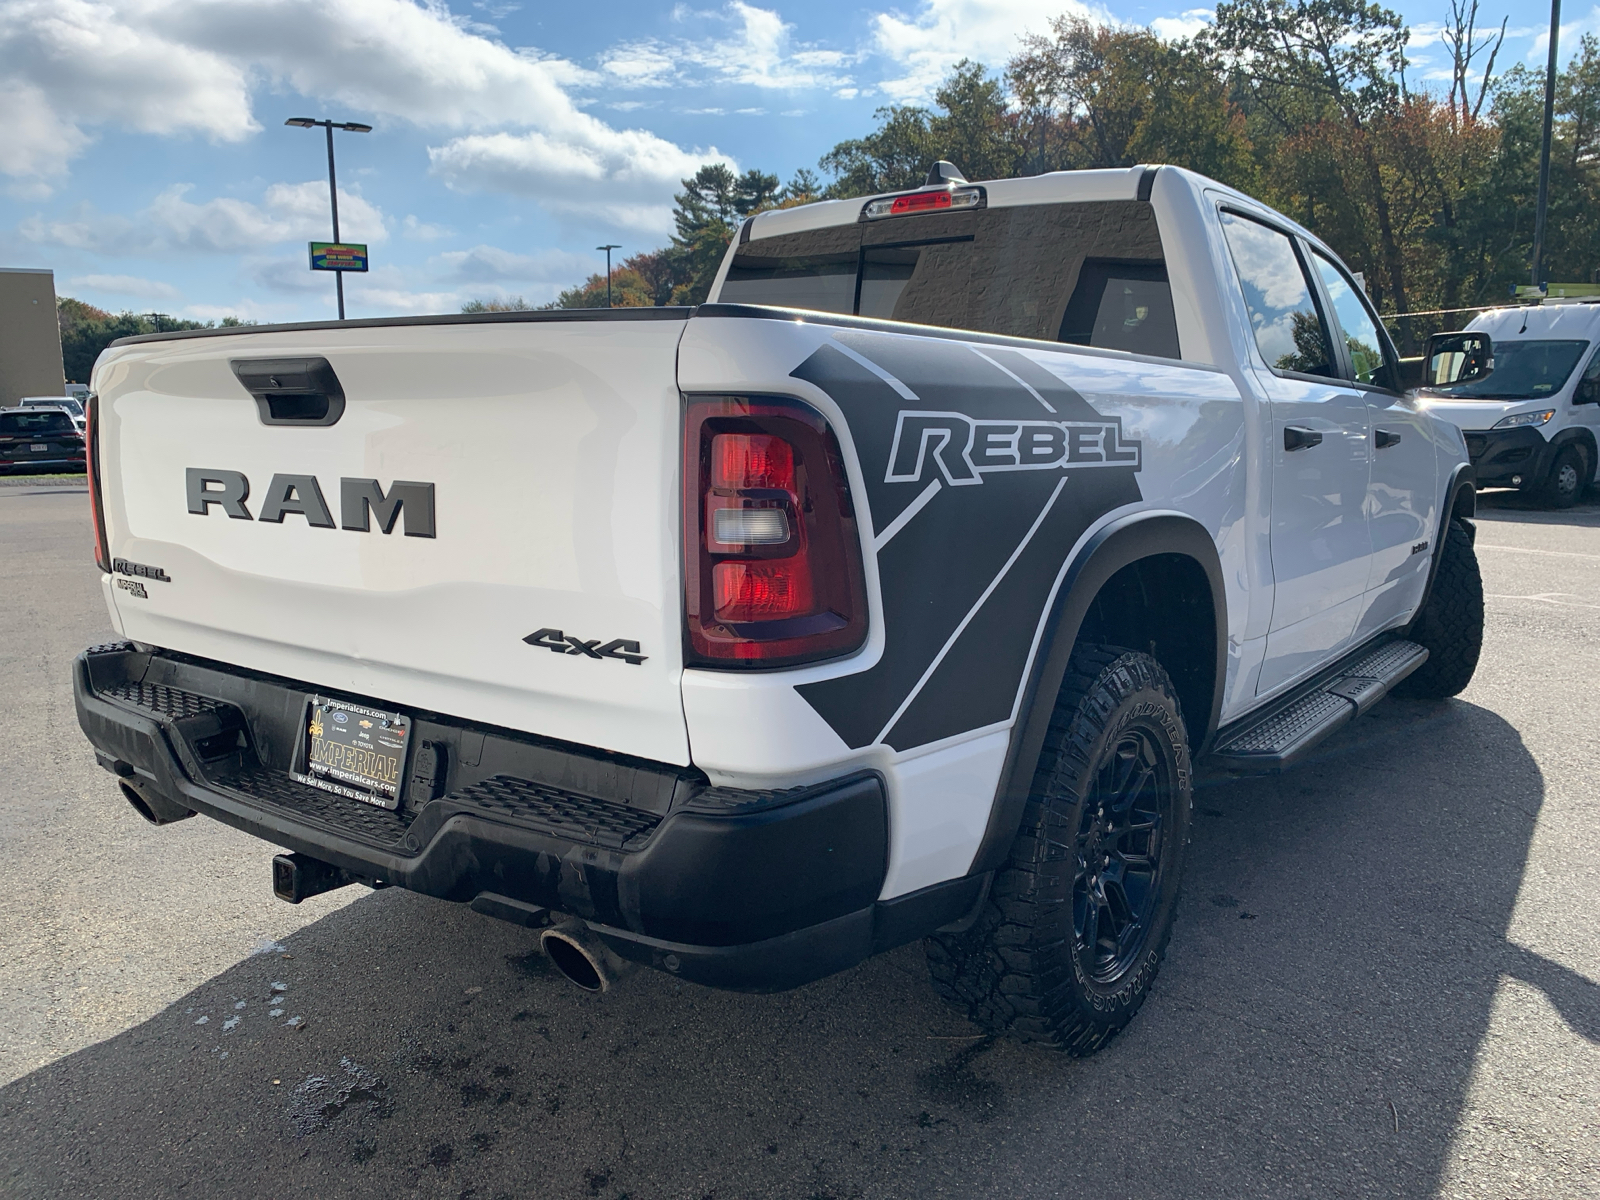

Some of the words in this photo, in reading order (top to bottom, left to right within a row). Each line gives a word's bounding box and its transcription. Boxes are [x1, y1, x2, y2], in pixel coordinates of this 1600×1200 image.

[884, 410, 1139, 486] REBEL
[186, 467, 436, 539] RAM
[113, 557, 171, 582] REBEL
[327, 699, 387, 720] Imperialcars.com
[357, 741, 374, 750] TOYOTA
[358, 731, 370, 740] Jeep
[310, 737, 398, 784] IMPERIAL
[297, 775, 306, 783] We
[306, 778, 317, 786] Sell
[343, 788, 354, 797] You
[355, 792, 369, 801] Save
[371, 796, 386, 807] More
